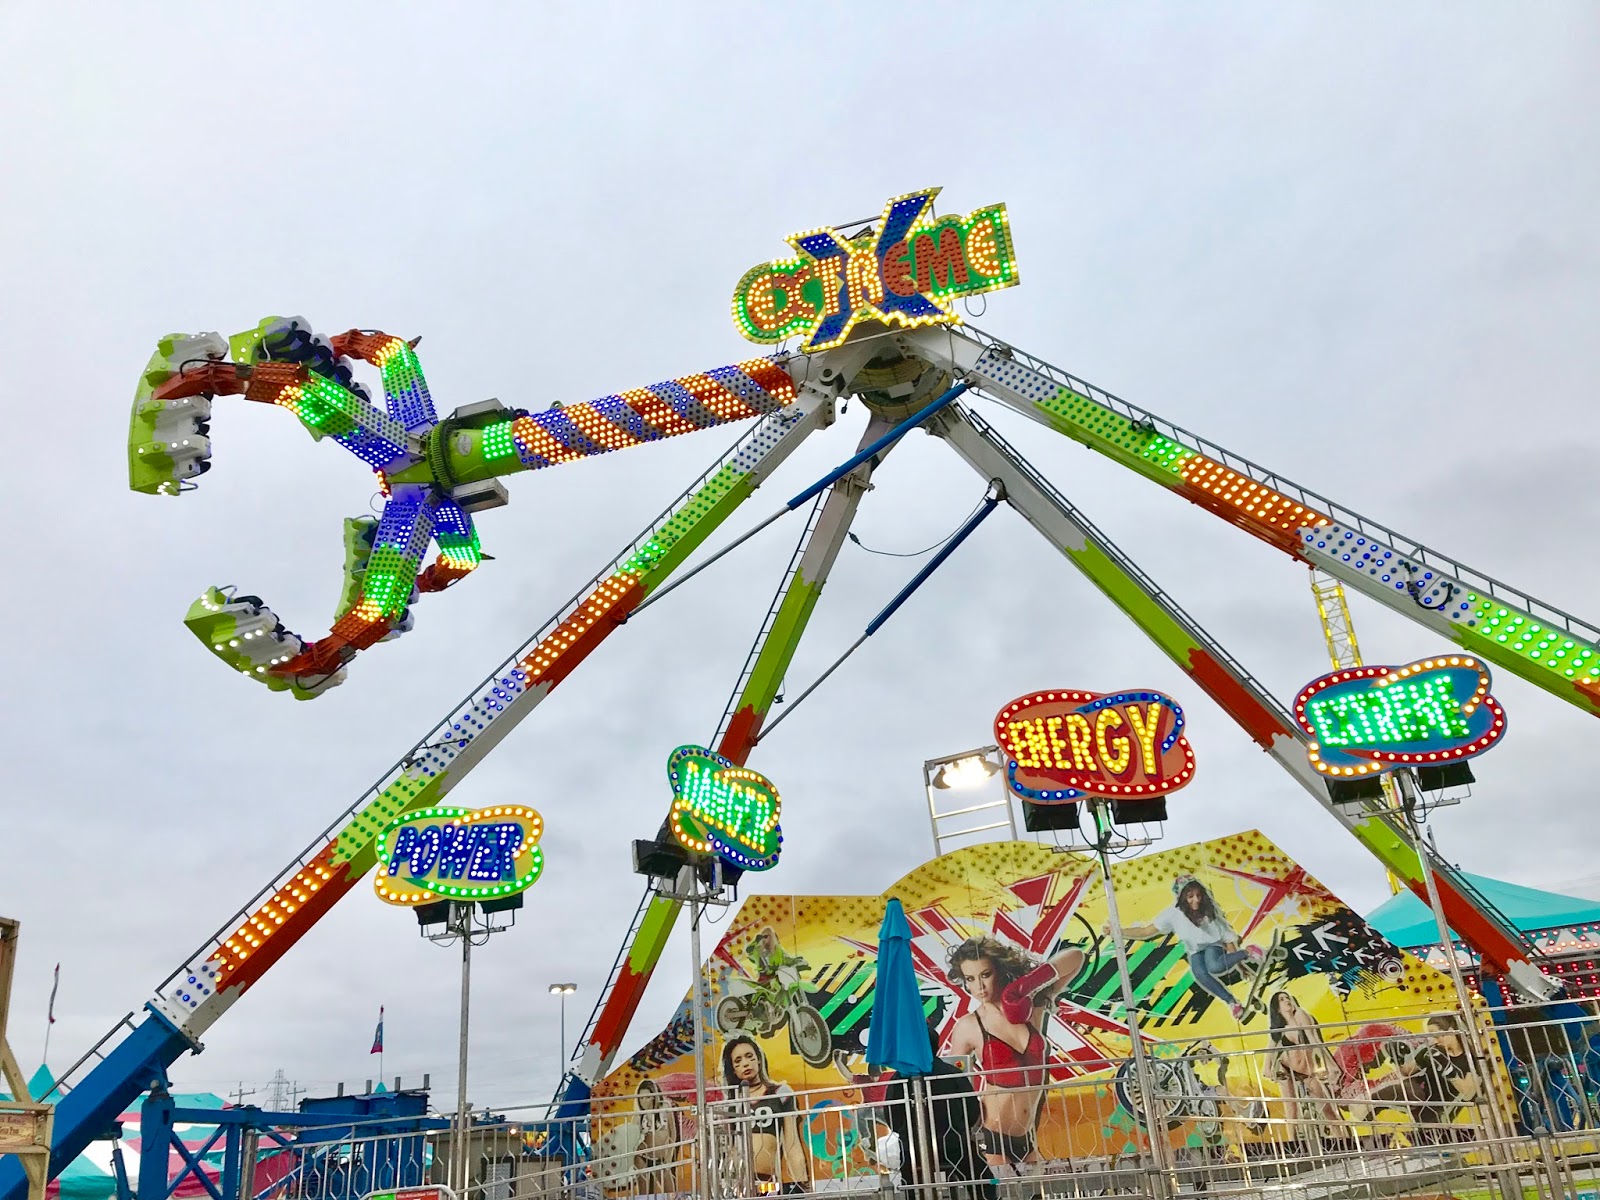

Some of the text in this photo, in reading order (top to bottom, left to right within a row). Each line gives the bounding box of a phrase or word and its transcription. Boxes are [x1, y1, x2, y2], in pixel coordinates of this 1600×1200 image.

[746, 217, 1001, 330] EXTREME
[1008, 702, 1163, 776] ENERGY
[1310, 675, 1471, 747] EXTREME
[388, 822, 524, 882] POWER
